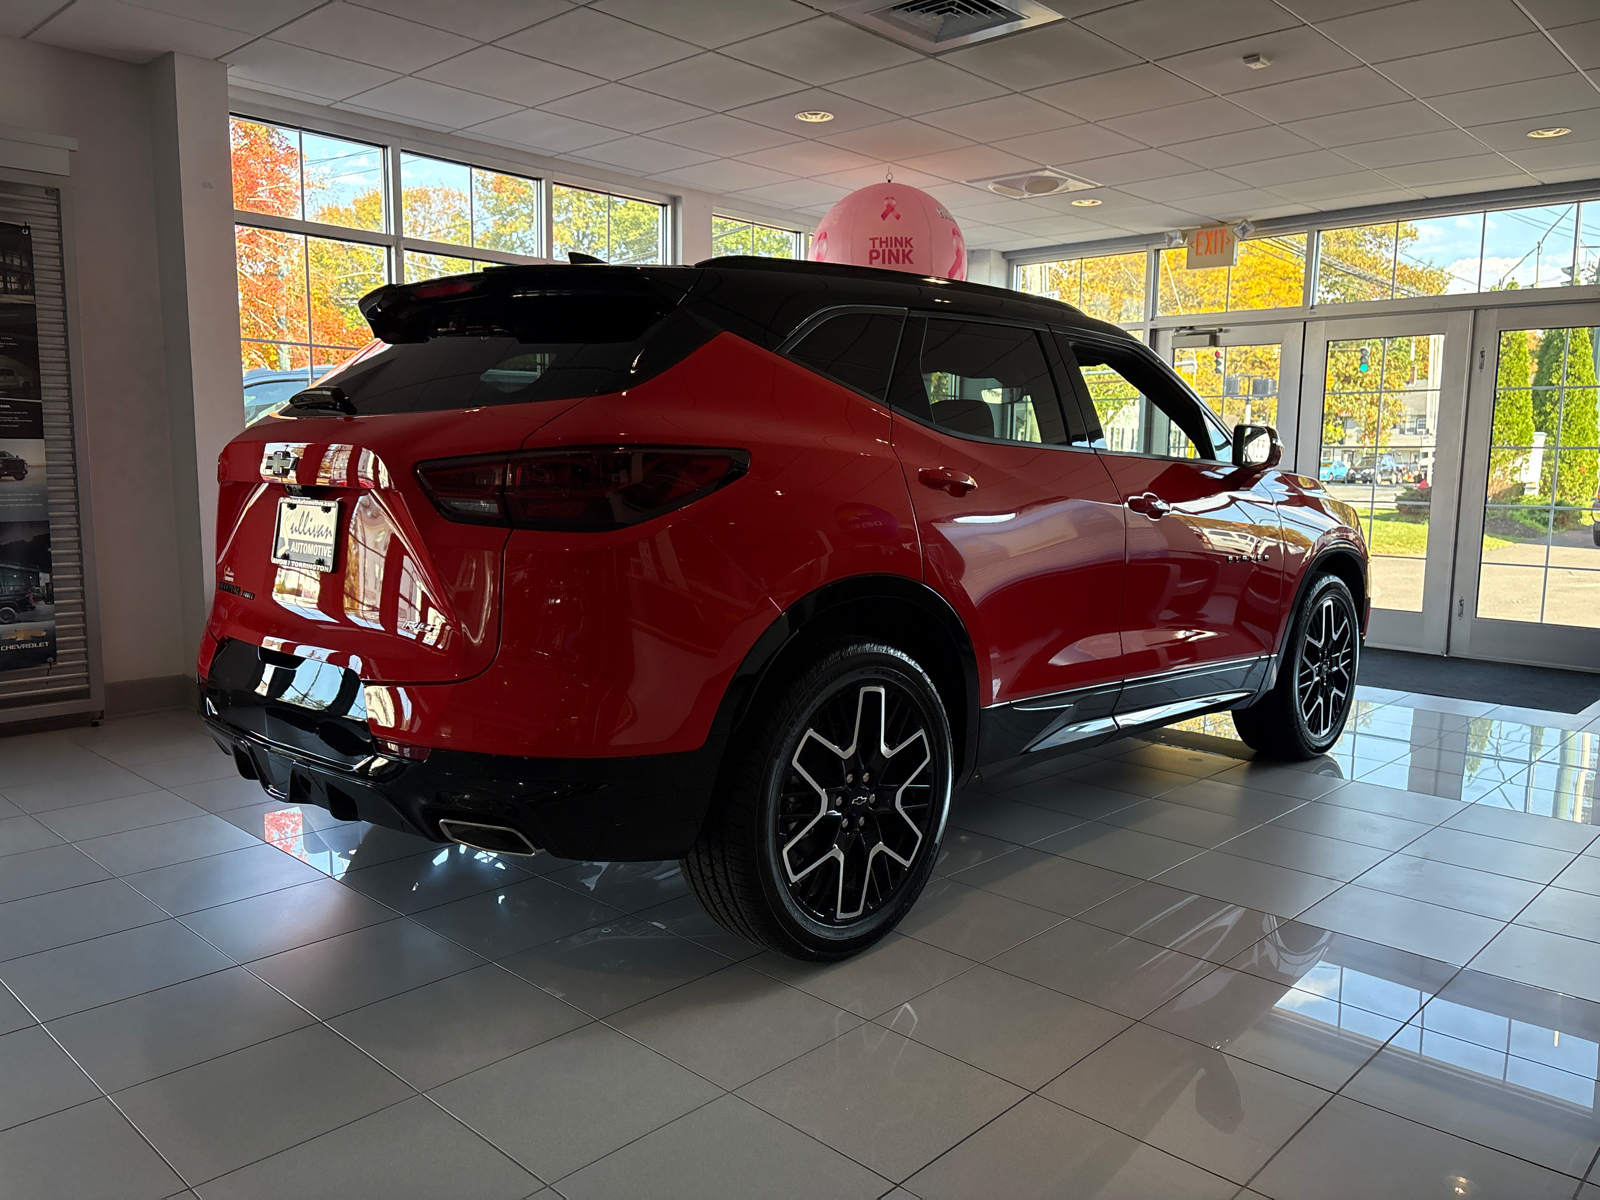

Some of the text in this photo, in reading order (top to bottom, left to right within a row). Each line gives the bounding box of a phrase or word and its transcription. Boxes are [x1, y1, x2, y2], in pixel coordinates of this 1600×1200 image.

[868, 236, 914, 249] THINK
[1195, 228, 1227, 256] EXIT
[868, 249, 914, 265] PINK
[277, 509, 333, 557] Sullivan
[290, 541, 332, 558] AUTOMOTIVE
[271, 557, 287, 566] AVON
[291, 560, 330, 573] TORRINGTON
[0, 641, 49, 651] CHEVROLET
